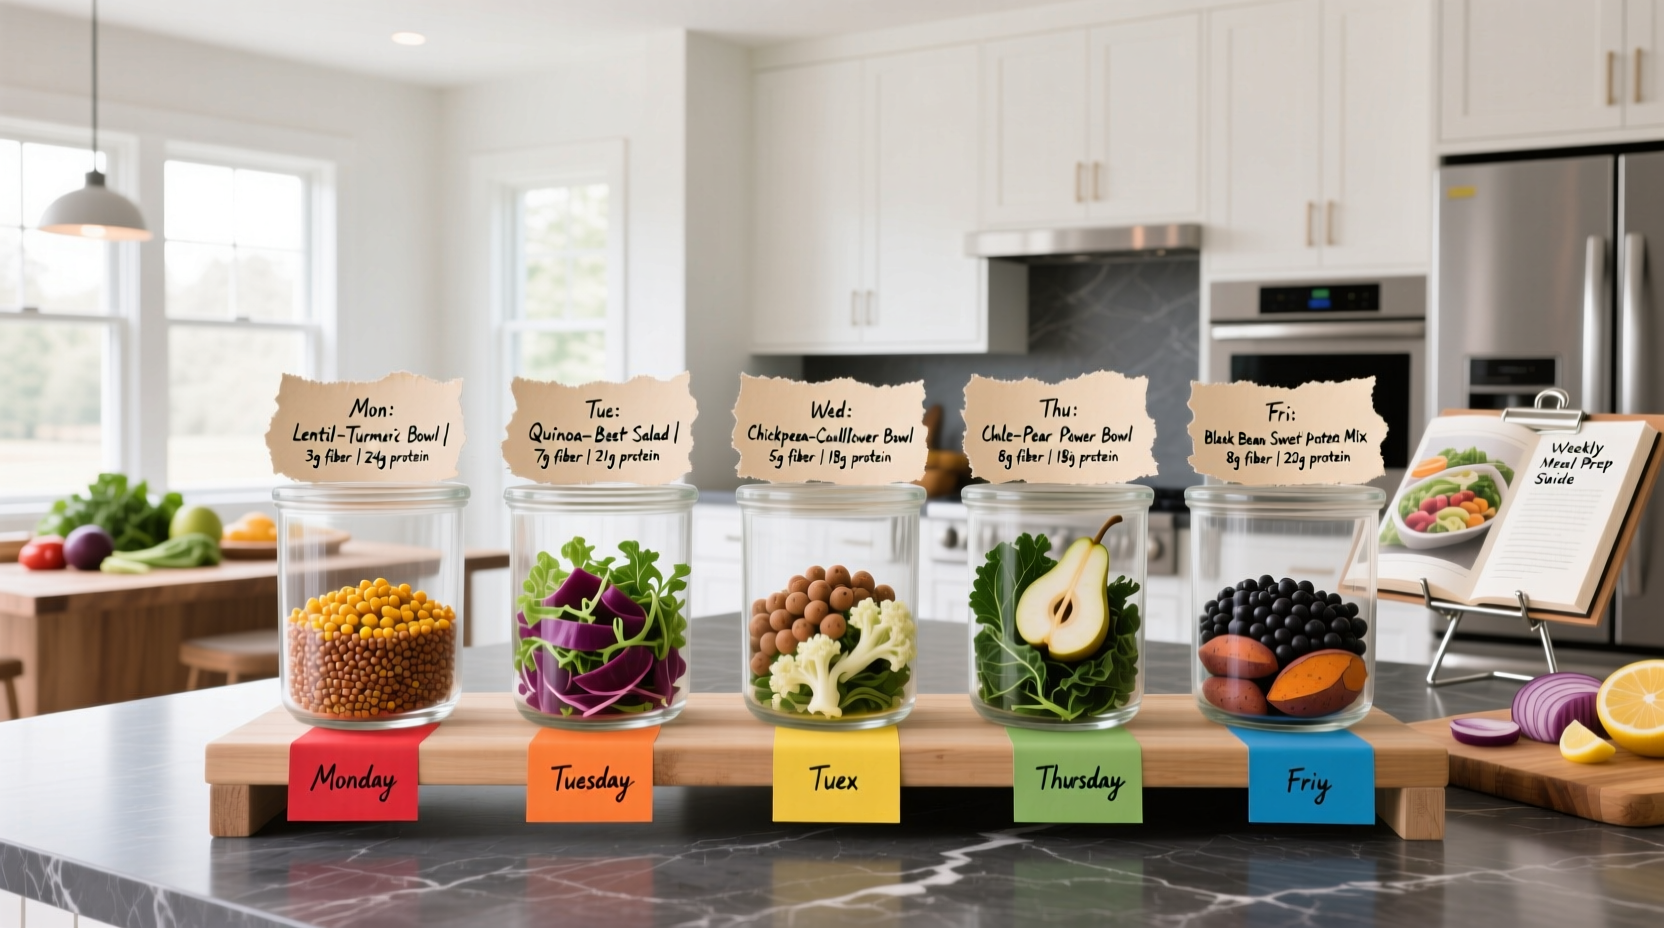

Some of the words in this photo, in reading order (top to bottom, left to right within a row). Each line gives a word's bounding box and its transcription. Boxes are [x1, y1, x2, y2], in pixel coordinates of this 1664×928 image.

[349, 398, 393, 417] Mon:
[586, 399, 619, 418] Tue:
[812, 400, 851, 418] Wed:
[1040, 398, 1077, 418] Thu:
[1266, 402, 1295, 421] Fri:
[408, 425, 439, 443] Bowl
[633, 424, 669, 442] Salad
[1102, 425, 1133, 443] Bowl
[1344, 429, 1367, 443] Mix
[306, 450, 320, 468] 3g
[325, 448, 352, 465] fiber
[390, 450, 428, 469] protein
[534, 449, 549, 469] 7g
[554, 448, 583, 464] fiber
[596, 450, 615, 469] 21g
[769, 449, 783, 469] 5g
[851, 450, 891, 469] protein
[1553, 441, 1604, 458] Weekly
[1227, 451, 1240, 470] 8g
[1245, 451, 1272, 466] fiber
[310, 764, 396, 802] Monday
[551, 765, 634, 802] Tuesday
[809, 765, 857, 791] Tuex
[1036, 764, 1125, 801] Thursday
[1288, 768, 1332, 805] Friy
